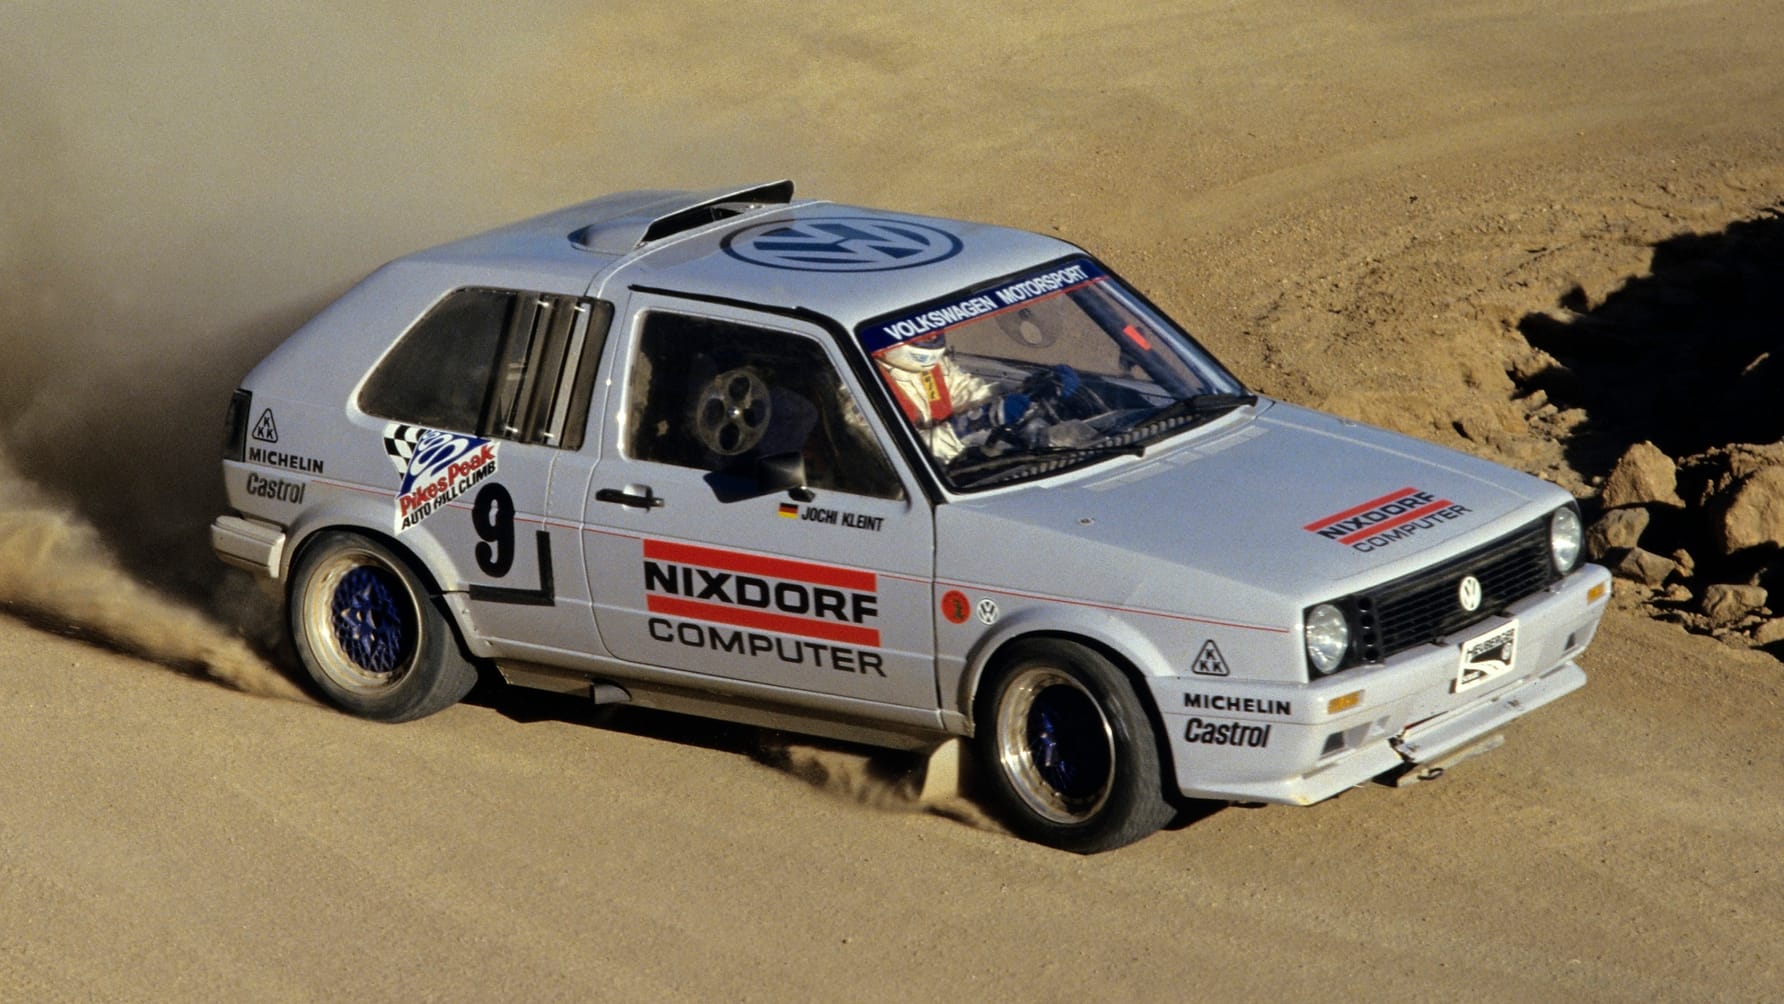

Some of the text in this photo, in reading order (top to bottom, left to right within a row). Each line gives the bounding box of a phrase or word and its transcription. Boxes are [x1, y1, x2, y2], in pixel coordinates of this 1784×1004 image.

[884, 265, 1089, 340] VOLKSWAGEN MOTORSPORT
[249, 447, 324, 474] MICHELIN
[400, 445, 495, 517] Pikes Peak
[247, 472, 306, 505] Castrol
[402, 460, 496, 530] AUTO HILL CLIMB
[472, 482, 515, 578] 9
[801, 507, 885, 532] JOCHI KLEINT
[1316, 491, 1435, 540] NIXDORF
[1351, 504, 1473, 553] COMPUTER
[644, 560, 878, 624] NIXDORF
[648, 617, 887, 678] COMPUTER
[1184, 692, 1292, 715] MICHELIN
[1184, 717, 1272, 748] Castrol
